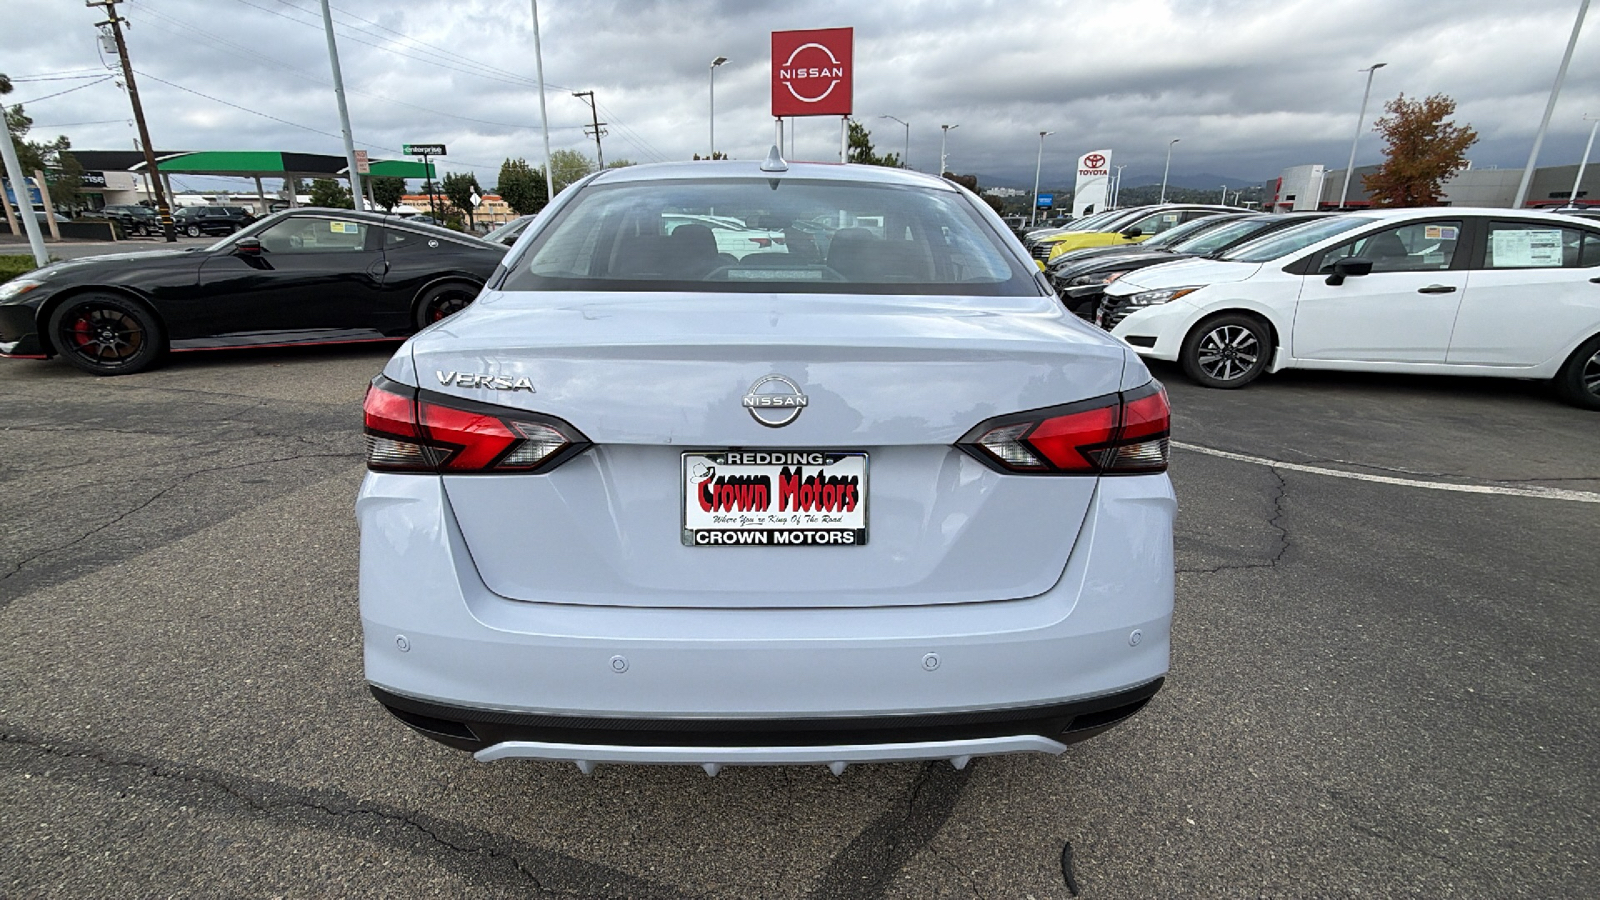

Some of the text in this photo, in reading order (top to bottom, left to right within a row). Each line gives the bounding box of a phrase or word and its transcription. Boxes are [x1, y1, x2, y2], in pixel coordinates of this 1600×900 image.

[780, 67, 843, 79] NISSAN
[405, 146, 442, 154] enterprise
[436, 370, 537, 393] VERSA
[743, 396, 807, 406] NISSAN
[727, 453, 824, 465] REDDING
[697, 466, 859, 513] Crown Motors
[712, 515, 843, 527] Where You're King Of The Road
[696, 531, 854, 544] CROWN MOTORS
